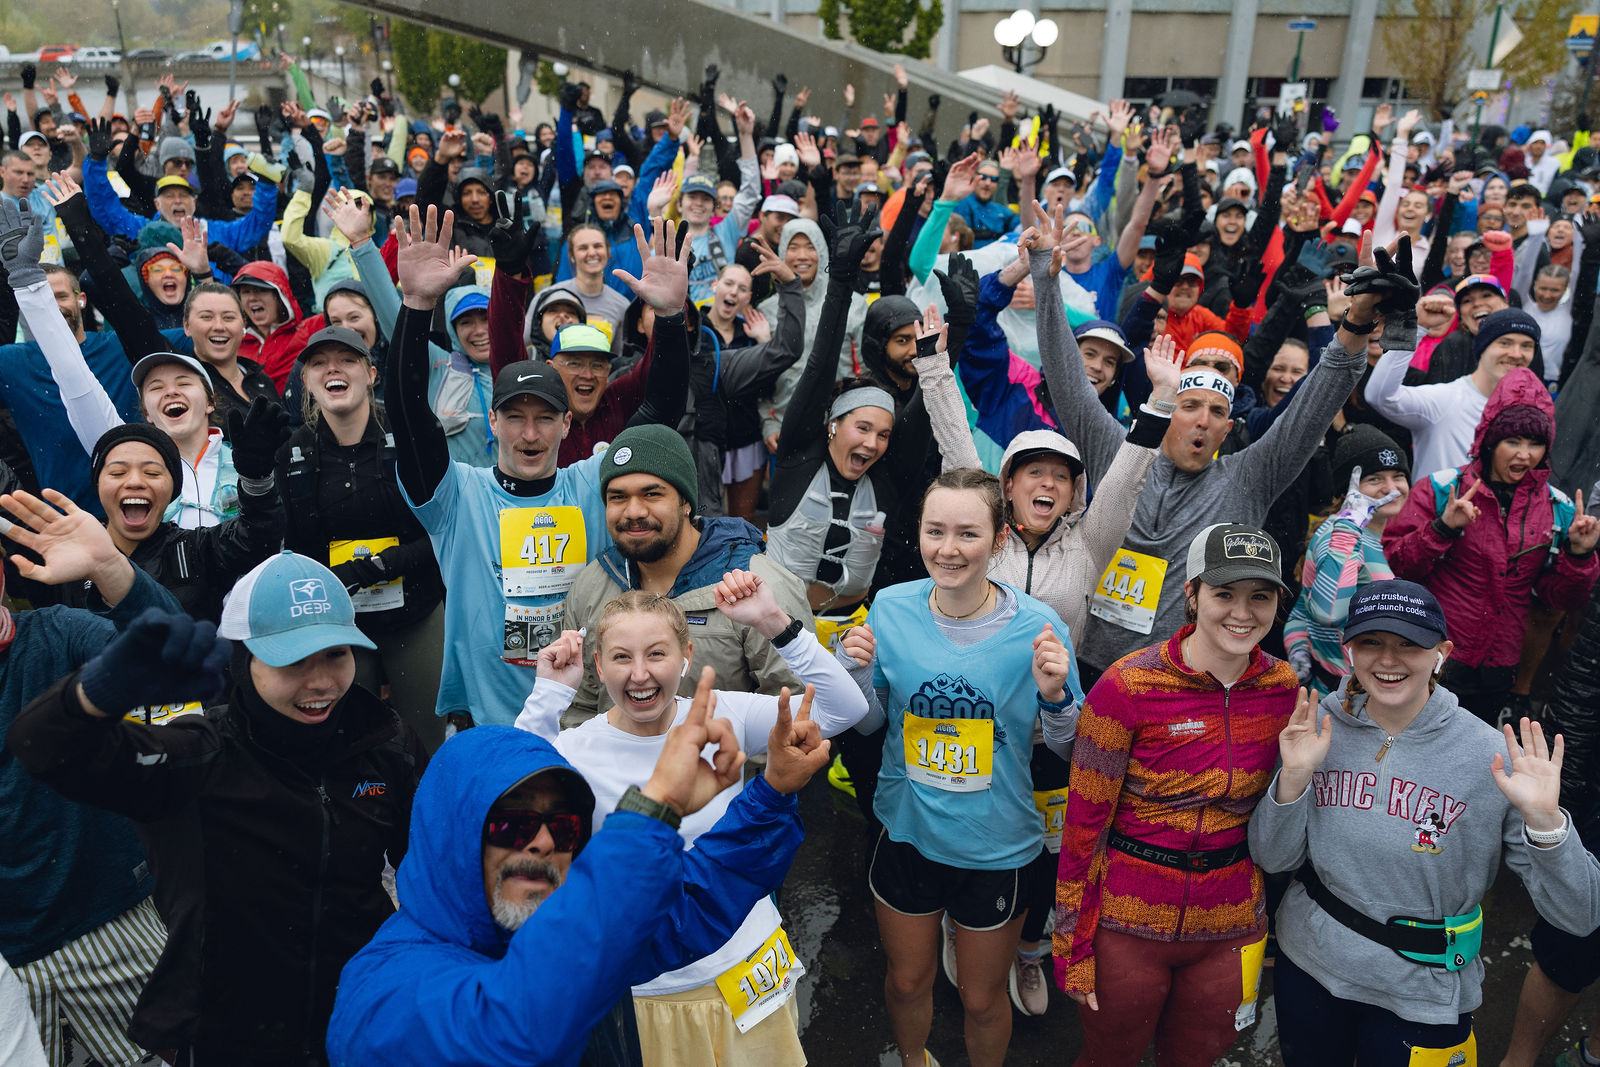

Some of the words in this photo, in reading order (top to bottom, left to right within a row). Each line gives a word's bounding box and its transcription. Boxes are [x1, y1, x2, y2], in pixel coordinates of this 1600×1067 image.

[520, 533, 570, 565] 417
[1102, 570, 1146, 605] 444
[1381, 593, 1409, 602] trusted
[1409, 597, 1425, 606] with
[1377, 603, 1404, 612] launch
[1405, 606, 1427, 618] codes
[917, 738, 979, 775] 1431
[739, 937, 791, 1008] 1974
